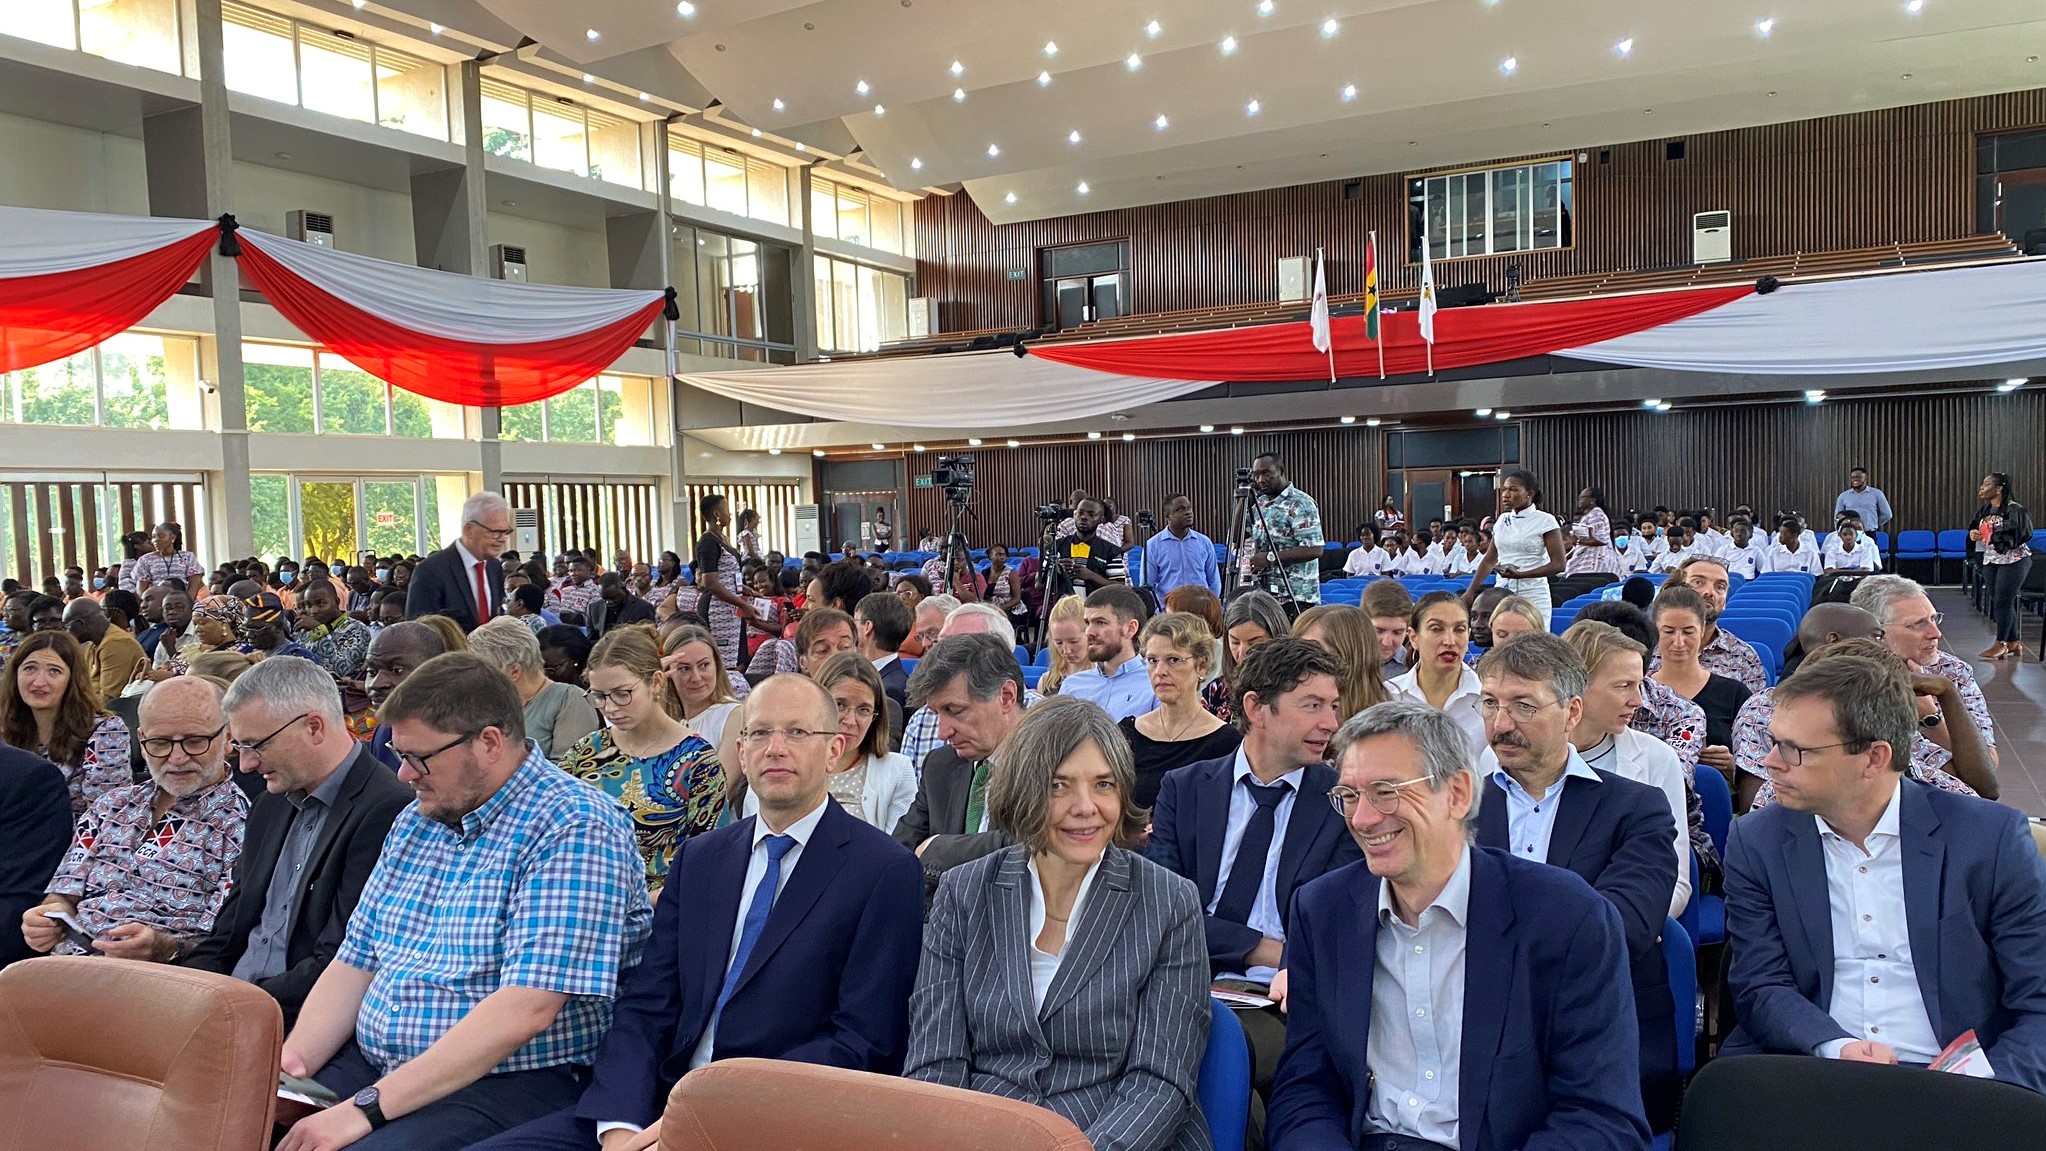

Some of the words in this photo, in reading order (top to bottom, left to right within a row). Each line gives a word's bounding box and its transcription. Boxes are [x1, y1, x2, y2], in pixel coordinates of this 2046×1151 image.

[1009, 270, 1024, 278] EXIT
[915, 477, 932, 486] EXIT
[377, 514, 393, 523] EXIT
